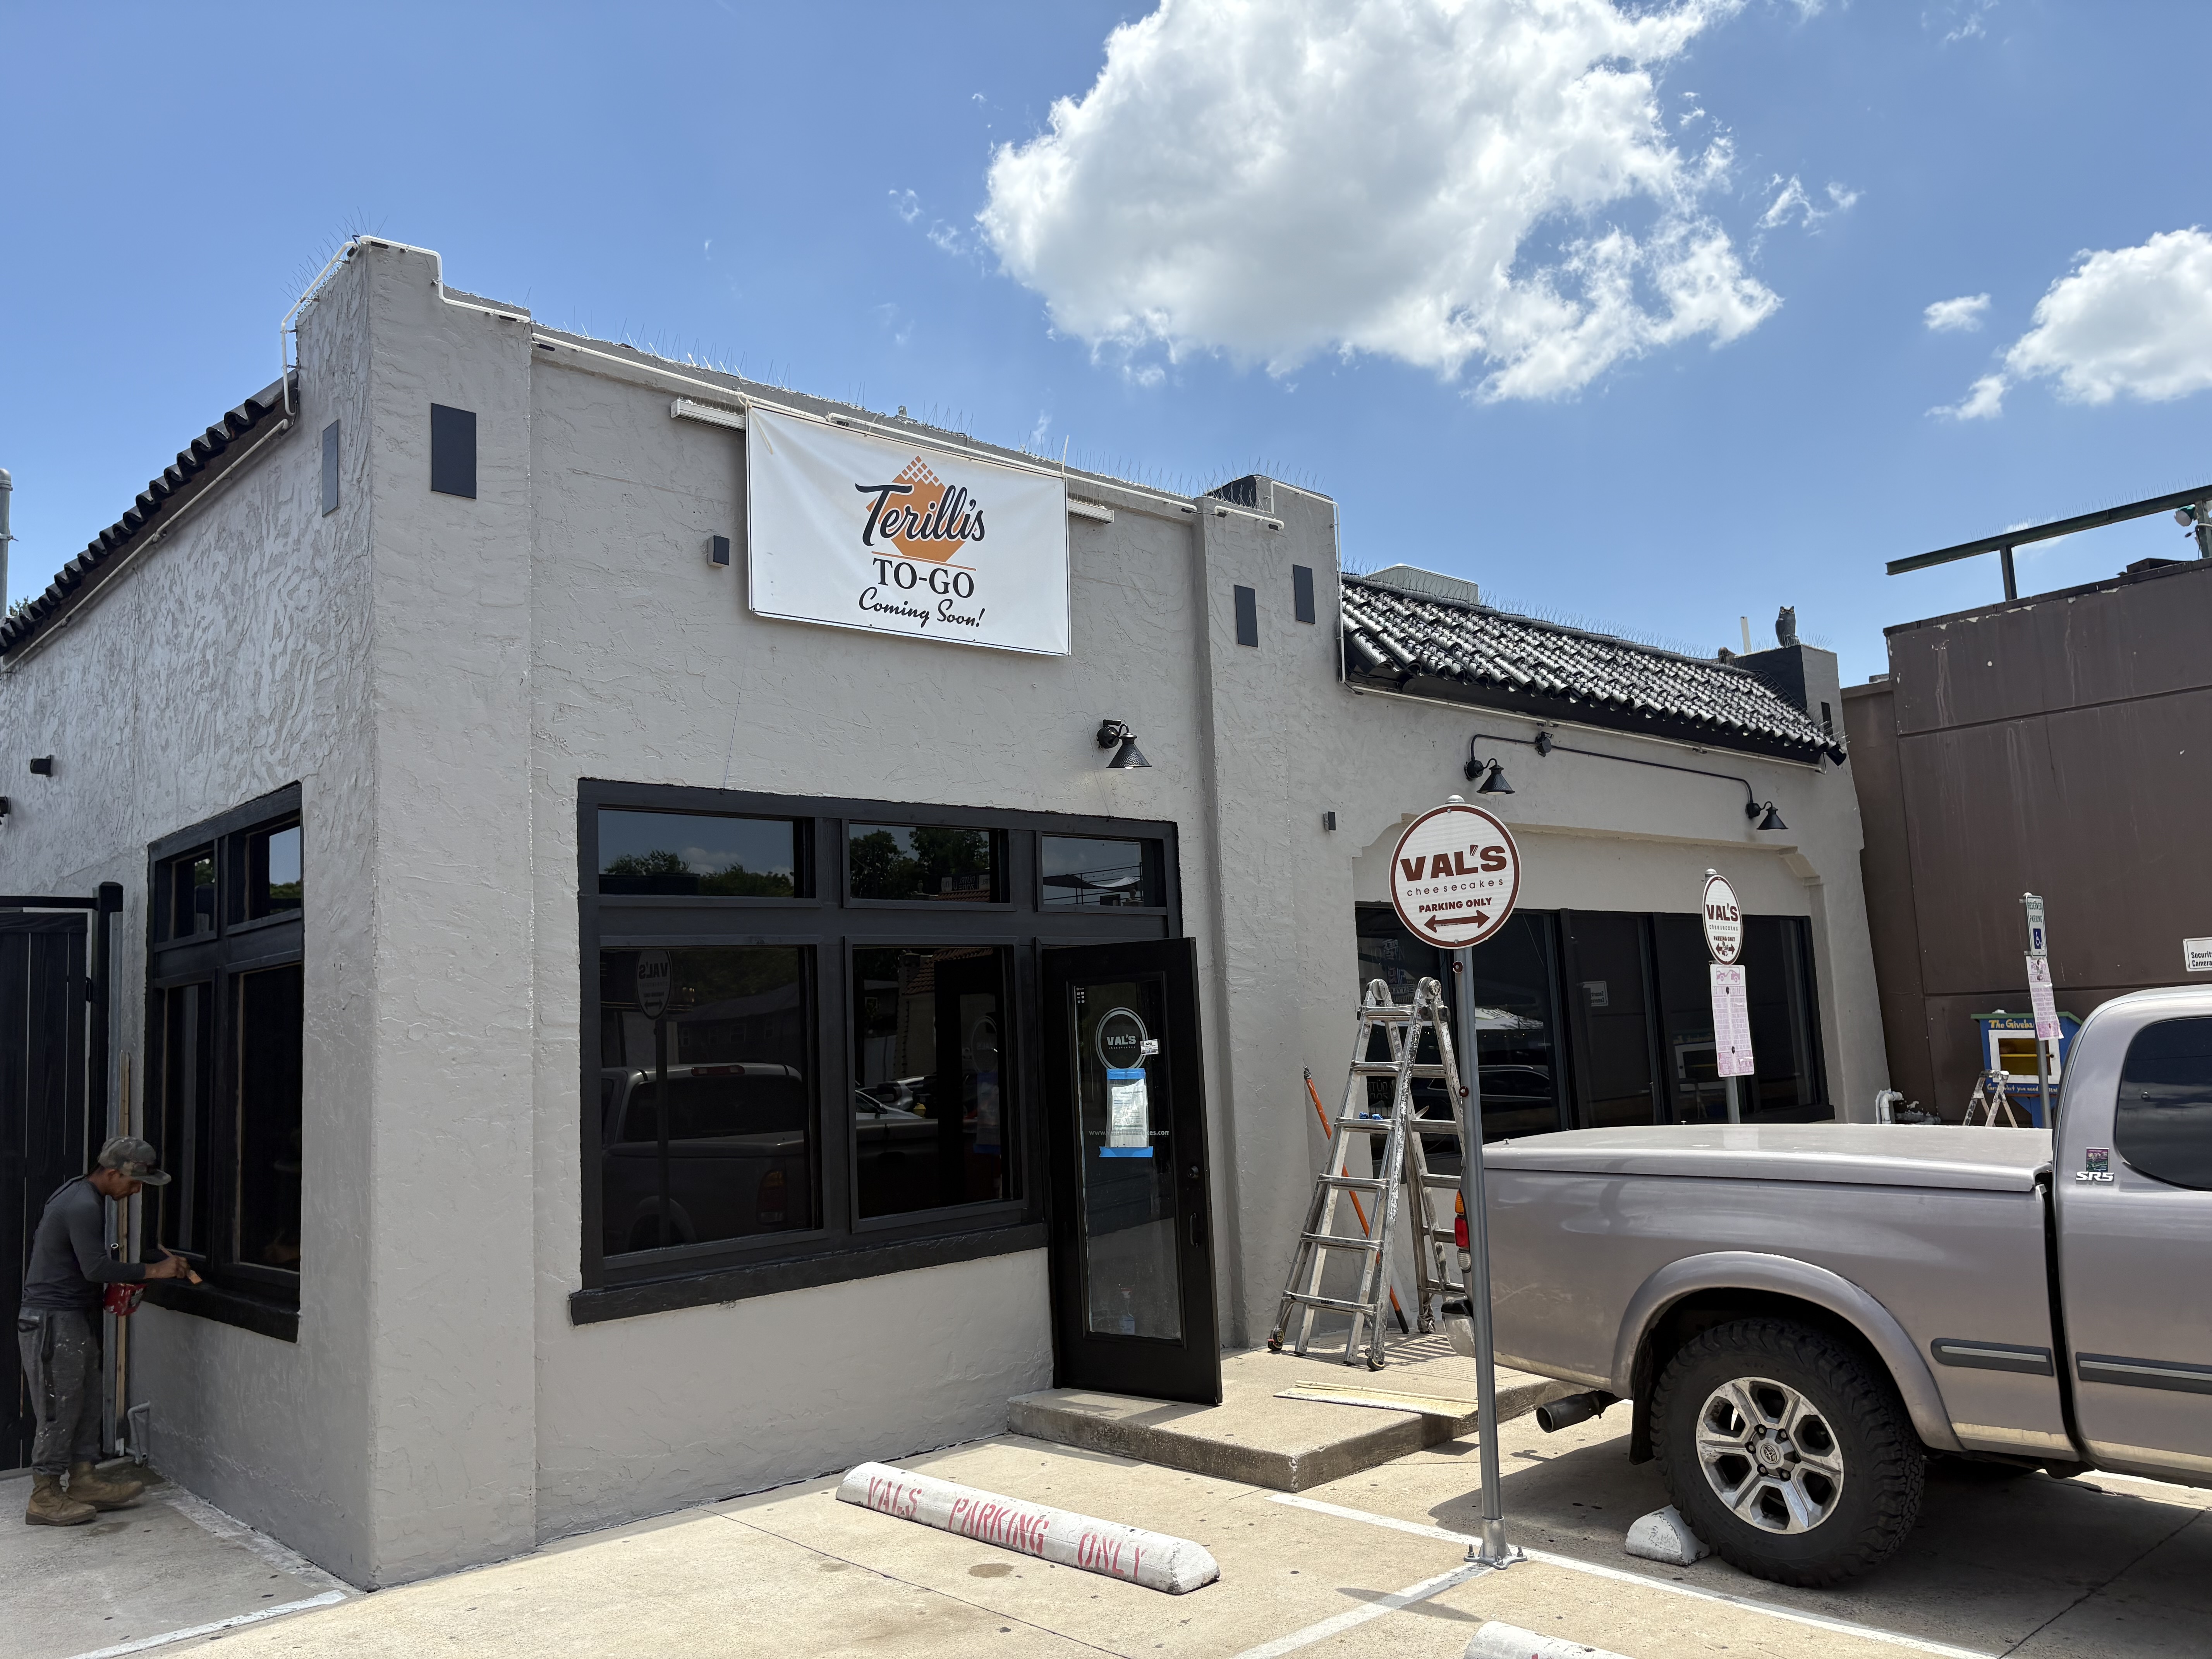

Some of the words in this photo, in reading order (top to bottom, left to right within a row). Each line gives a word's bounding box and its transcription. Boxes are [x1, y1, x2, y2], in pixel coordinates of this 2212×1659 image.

[855, 483, 985, 546] Terilli's
[872, 557, 975, 598] TO-GO
[859, 587, 930, 628] Coming
[936, 599, 985, 628] Soon!
[1400, 844, 1507, 882] VAL'S
[1407, 879, 1503, 896] cheesecakes
[1419, 900, 1463, 913] PARKING
[1466, 897, 1492, 907] ONLY
[1706, 902, 1738, 922] VAL'S
[2030, 915, 2042, 923] PARKING
[1989, 1019, 2004, 1029] The
[2006, 1019, 2034, 1029] Giveba
[1106, 1034, 1136, 1045] VAL'S
[2076, 1171, 2114, 1182] SR5
[866, 1476, 922, 1518] VALS
[948, 1497, 1049, 1554] PARKING
[1077, 1532, 1146, 1578] ONLY
